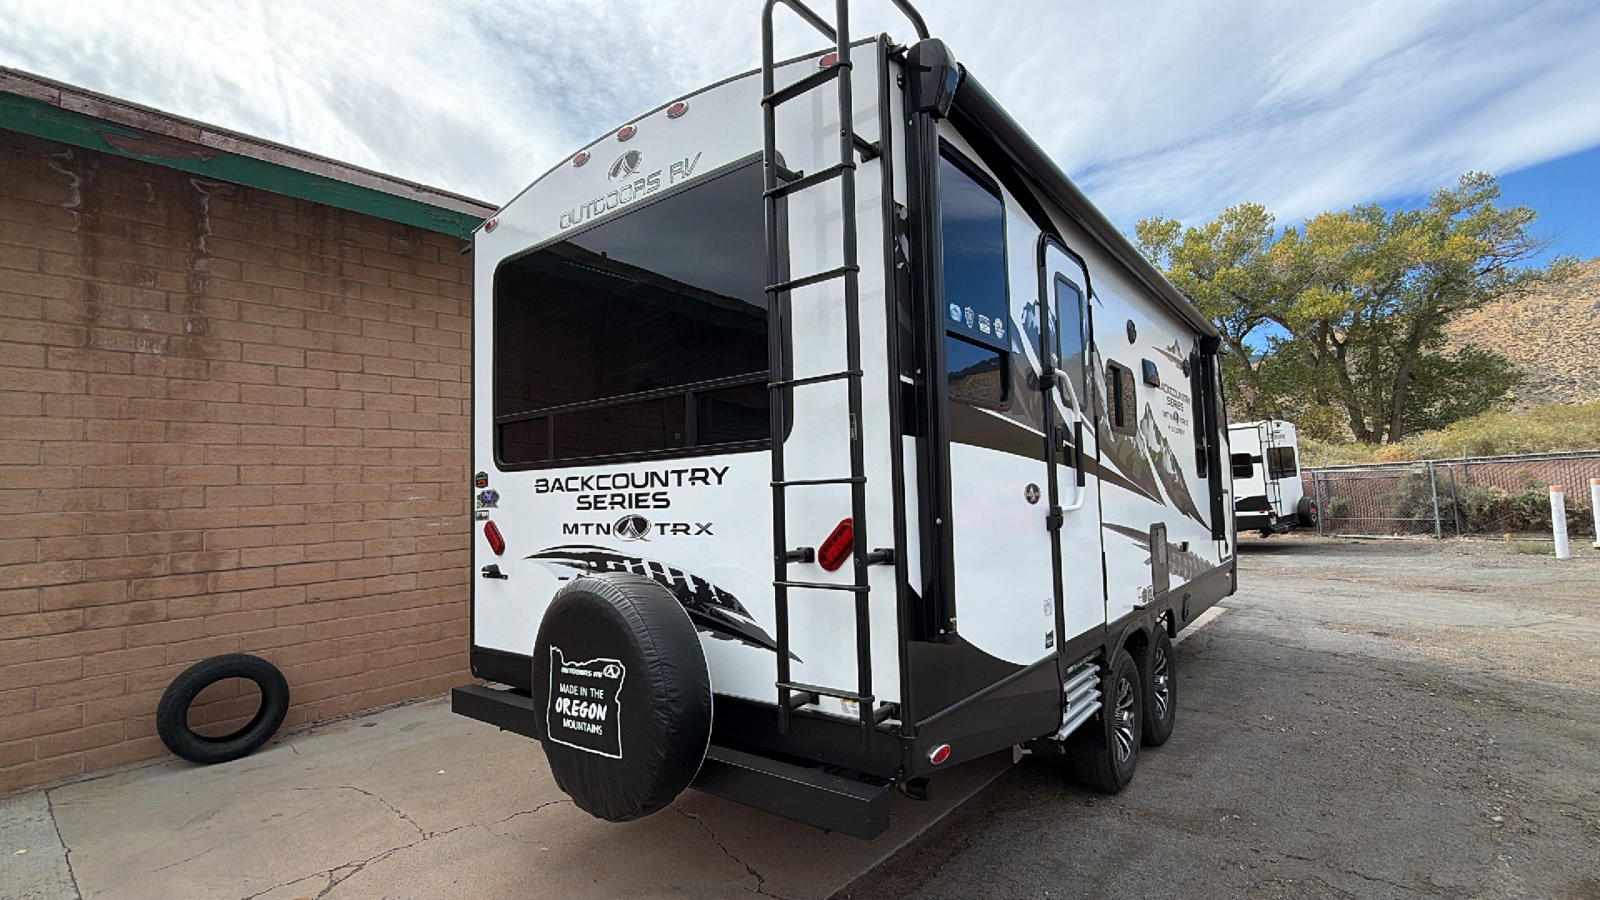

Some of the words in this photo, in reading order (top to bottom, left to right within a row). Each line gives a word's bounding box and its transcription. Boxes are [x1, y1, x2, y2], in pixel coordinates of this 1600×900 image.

[559, 169, 662, 230] OUTDOORS
[669, 151, 703, 184] RV
[534, 466, 730, 494] BACKCOUNTRY
[576, 491, 671, 511] SERIES
[562, 522, 611, 536] MTN
[654, 522, 714, 536] TRX
[561, 667, 592, 677] OUTDOORS
[559, 683, 578, 696] MADE
[580, 685, 588, 697] IN
[590, 688, 604, 699] THE
[555, 697, 607, 720] OREGON
[562, 718, 602, 735] MOUNTAINS
